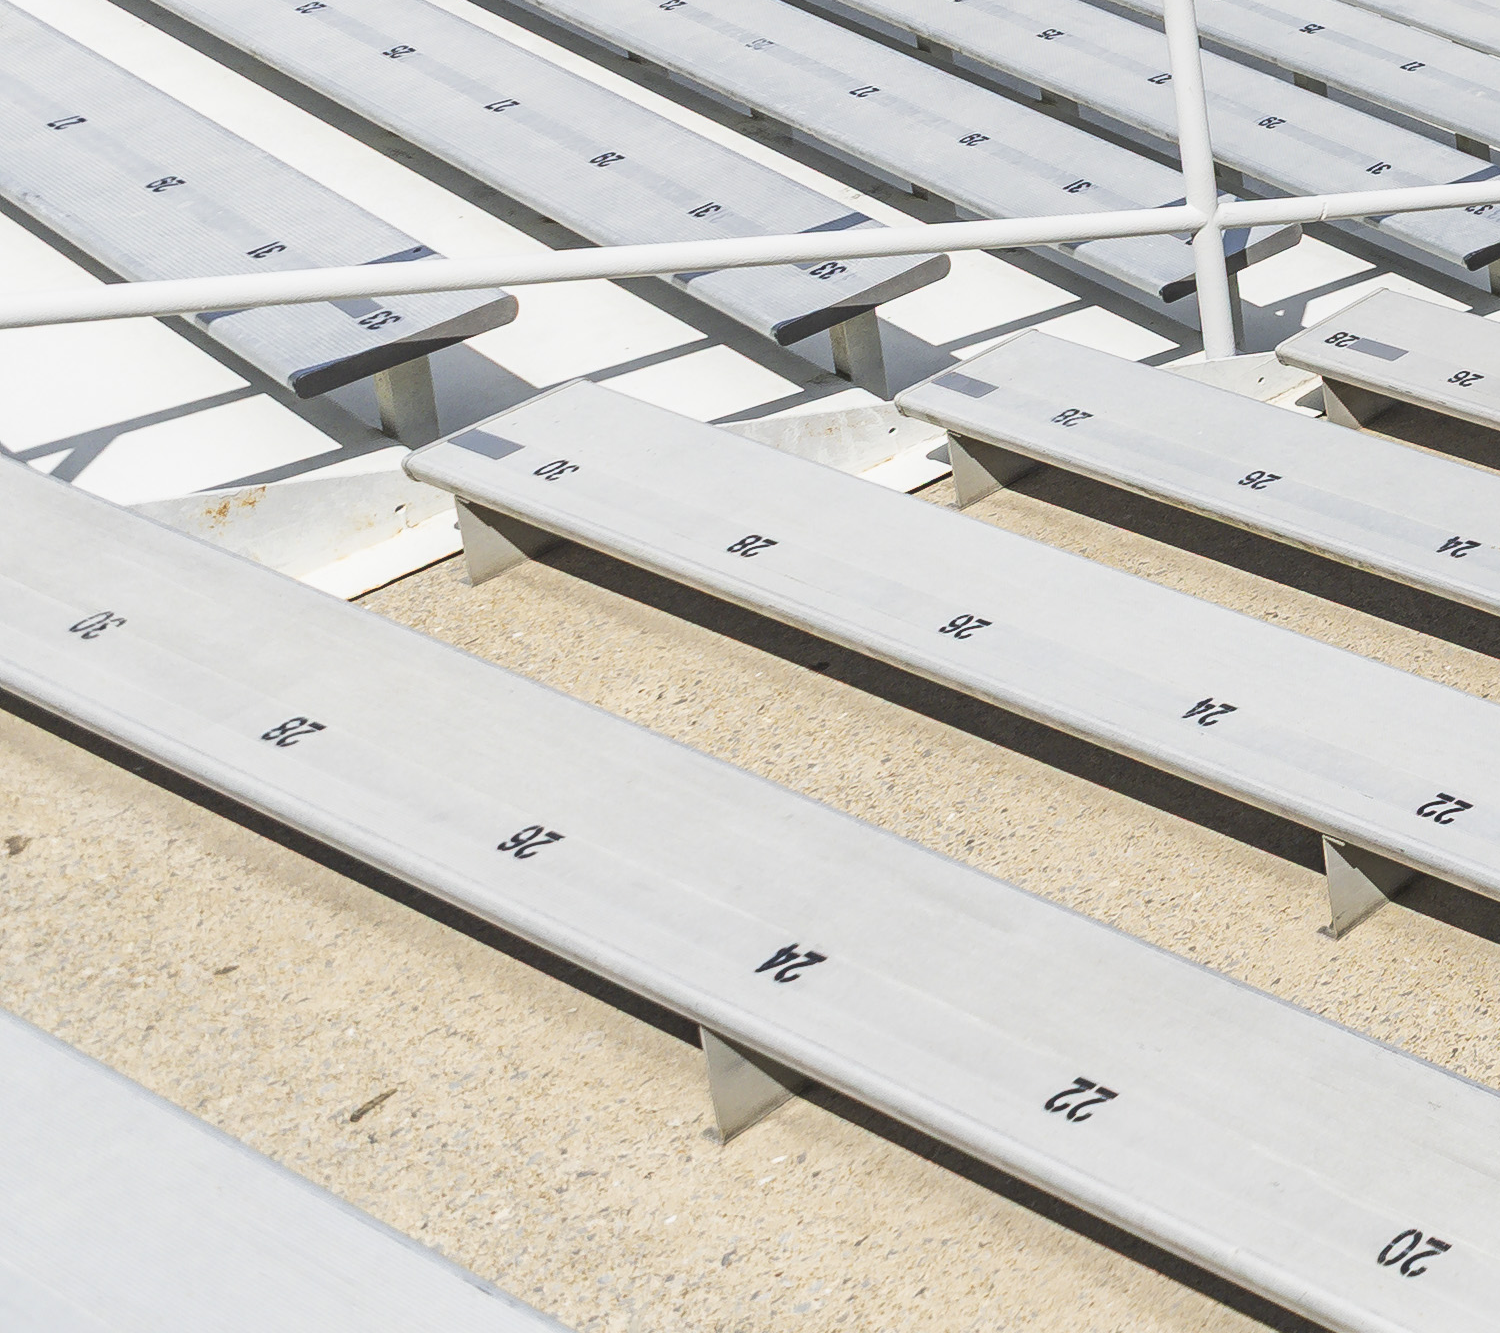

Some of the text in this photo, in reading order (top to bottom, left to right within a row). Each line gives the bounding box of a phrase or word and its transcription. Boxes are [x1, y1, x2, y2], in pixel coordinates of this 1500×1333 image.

[726, 534, 779, 558] 28
[938, 614, 993, 640] 26
[260, 716, 327, 748] 28
[1415, 792, 1474, 825] 22
[496, 825, 566, 860] 26
[754, 942, 828, 984] 24
[1043, 1076, 1119, 1123] 22
[1376, 1228, 1453, 1278] 20
